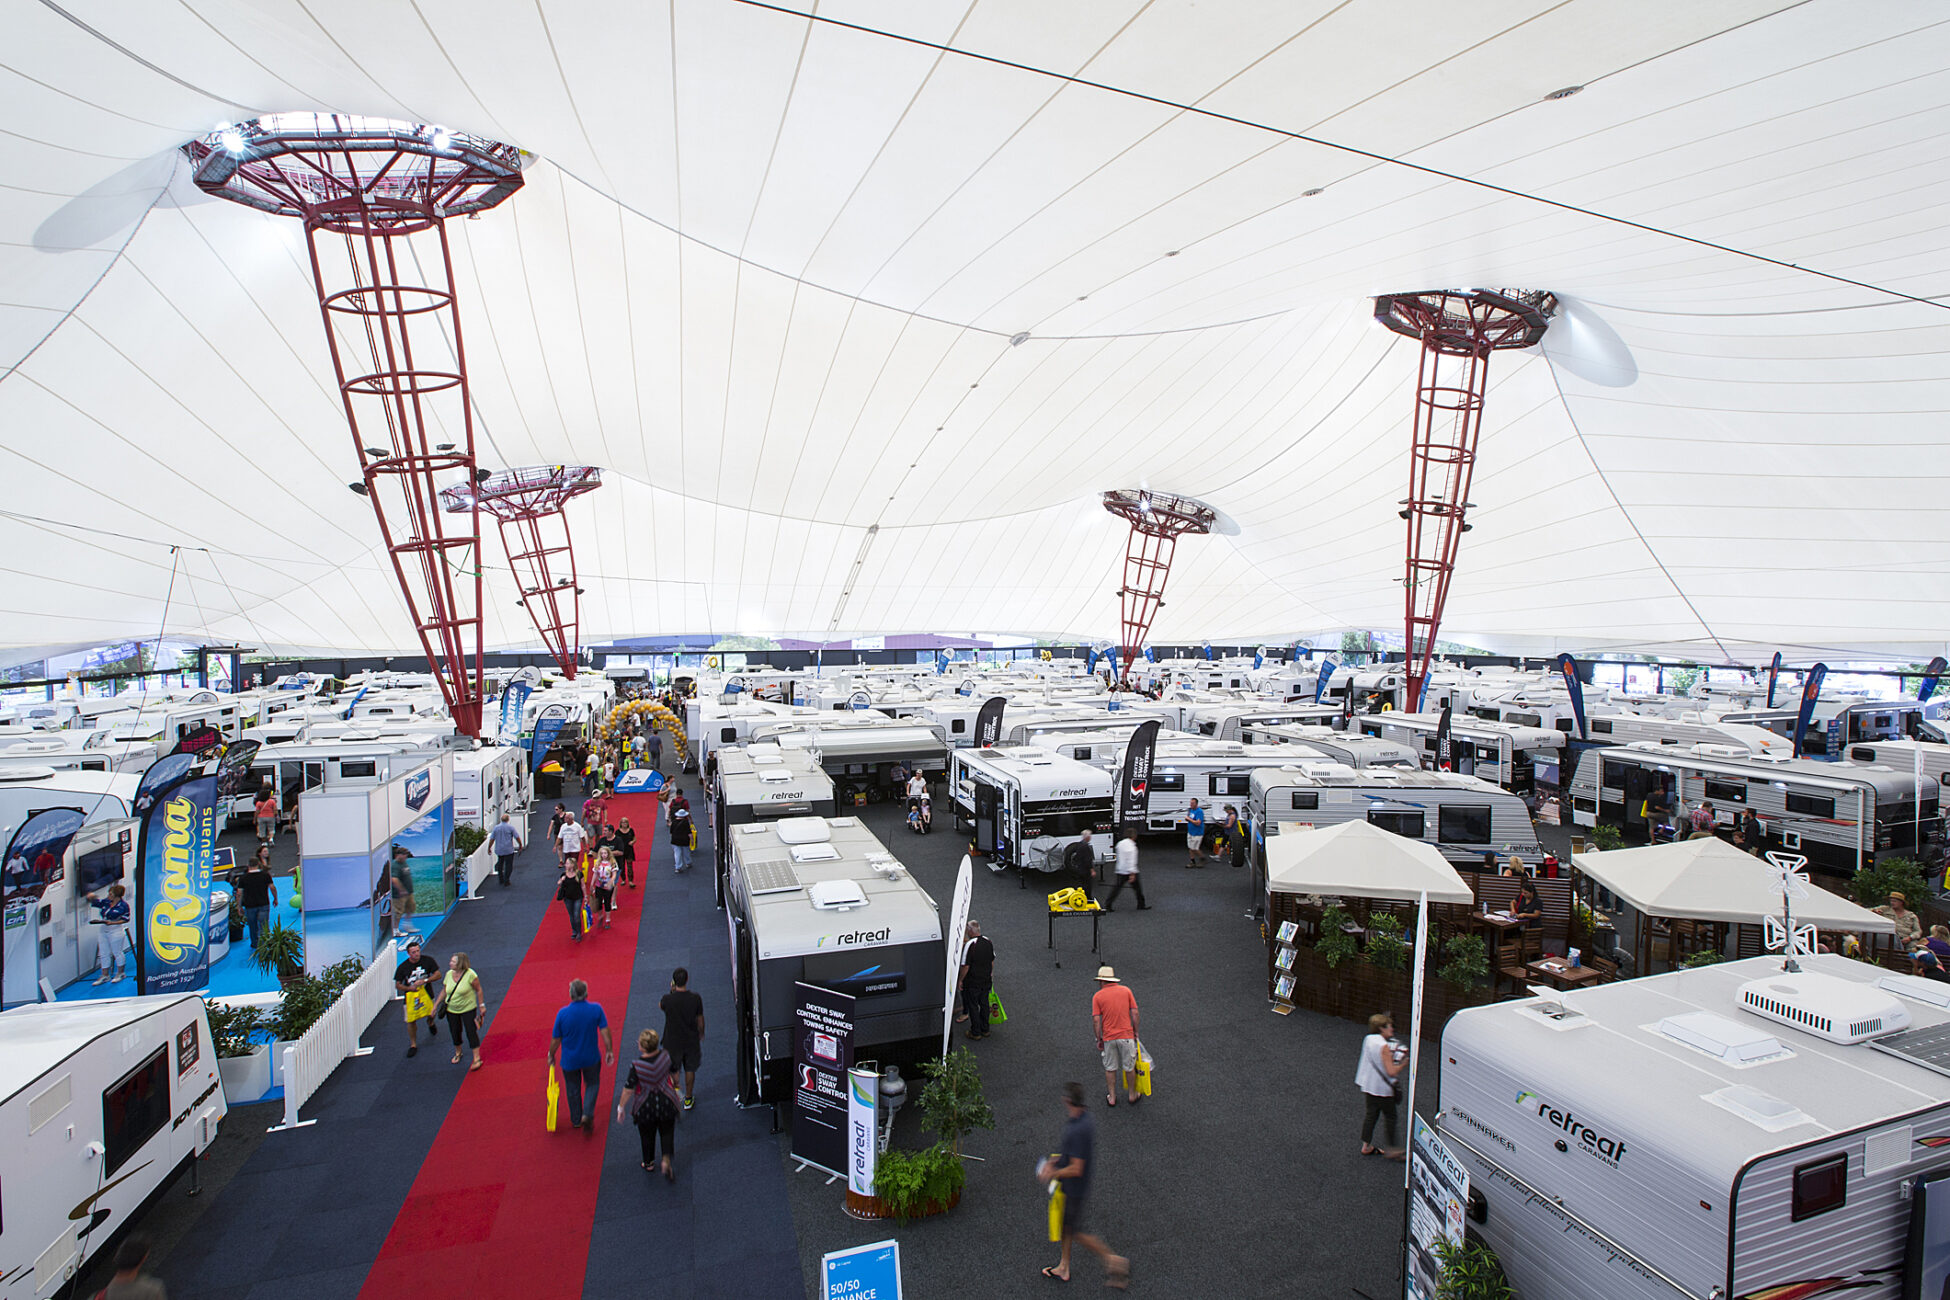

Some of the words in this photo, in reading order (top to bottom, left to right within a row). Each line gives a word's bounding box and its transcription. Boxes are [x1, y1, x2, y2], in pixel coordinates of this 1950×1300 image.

[502, 686, 518, 746] Roma
[1143, 745, 1151, 778] CONTROL
[771, 792, 803, 800] retreat
[1059, 788, 1087, 797] retreat
[200, 807, 213, 889] caravans
[1509, 843, 1539, 852] retreat
[149, 796, 205, 963] Roma
[837, 927, 891, 946] retreat
[147, 971, 179, 982] Roaming
[160, 979, 179, 988] Since
[796, 1009, 821, 1022] CONTROL
[822, 1016, 853, 1030] ENHANCES
[806, 1002, 829, 1015] DEXTER
[829, 1009, 846, 1020] SWAY
[803, 1018, 825, 1030] TOWING
[825, 1025, 848, 1038] SAFETY
[818, 1071, 838, 1082] DEXTER
[818, 1078, 838, 1088] SWAY
[1452, 1106, 1517, 1153] SPINNAKER
[1538, 1103, 1627, 1163] retreat
[853, 1120, 865, 1176] retreat
[1577, 1141, 1619, 1170] CARAVANS
[1428, 1138, 1466, 1186] retreat
[1475, 1158, 1508, 1182] comfort
[1508, 1179, 1529, 1196] that
[1525, 1193, 1565, 1222] follows
[1564, 1221, 1587, 1237] you
[830, 1279, 860, 1295] 50/50
[832, 1288, 876, 1300] NANCE
